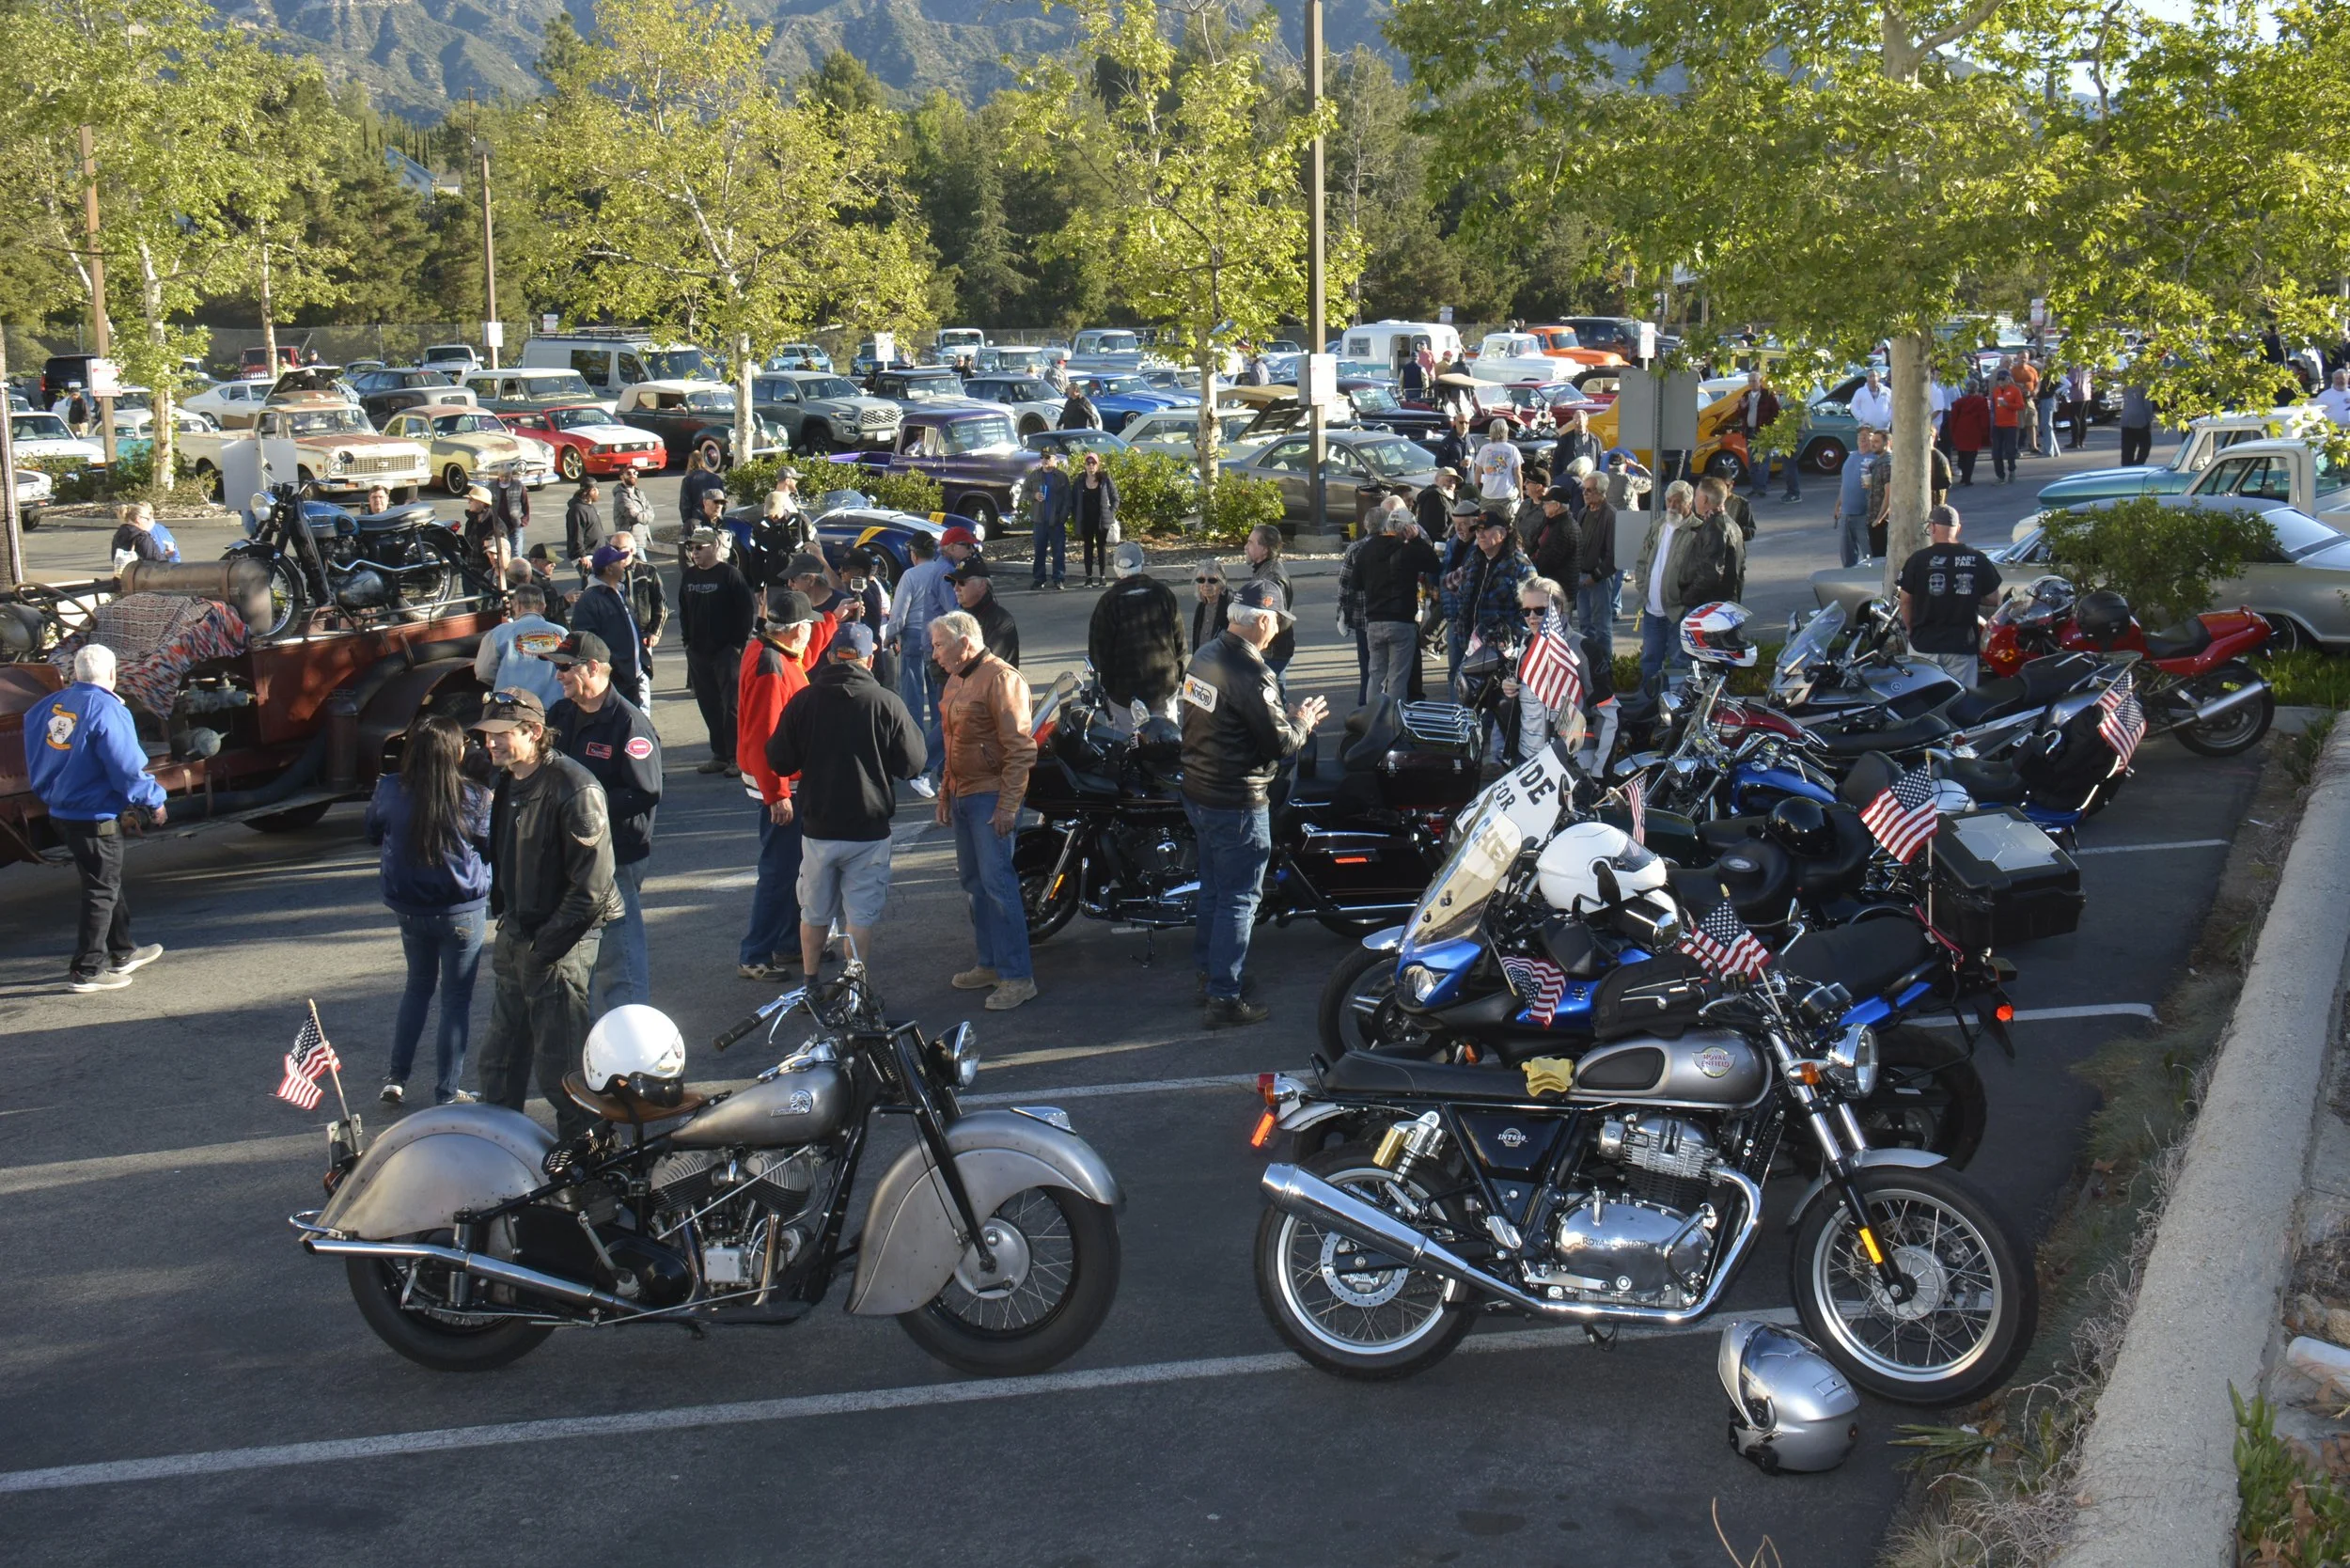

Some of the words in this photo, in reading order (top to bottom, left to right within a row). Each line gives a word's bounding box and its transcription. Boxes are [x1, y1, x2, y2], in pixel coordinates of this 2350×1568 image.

[1189, 682, 1213, 707] Norton
[1493, 780, 1516, 812] FOR
[1515, 758, 1557, 805] IDE
